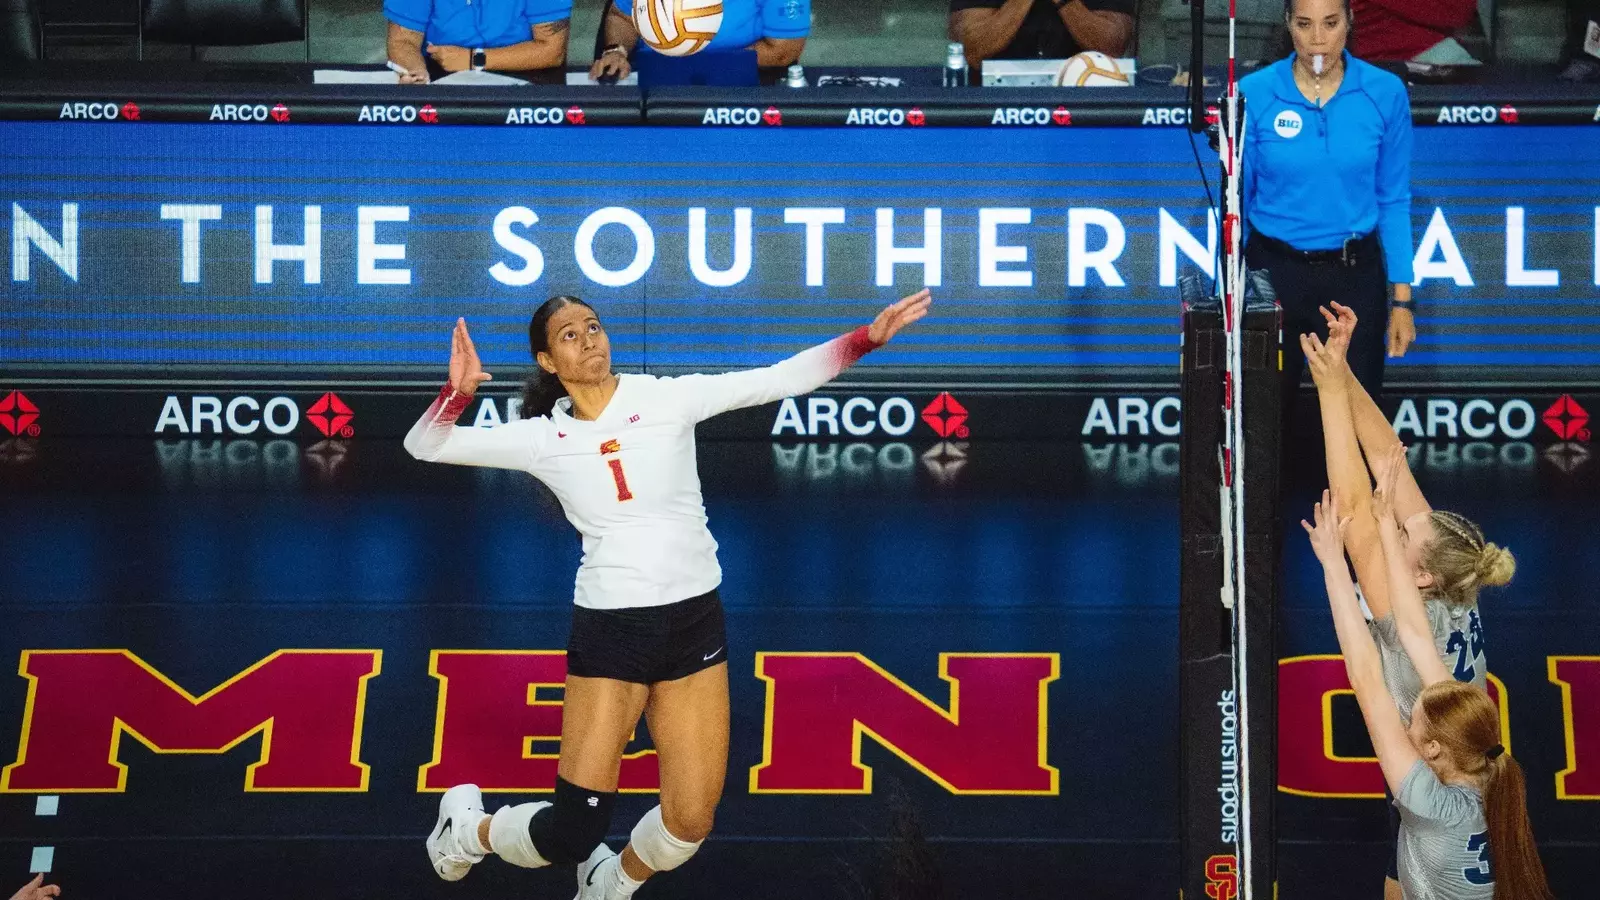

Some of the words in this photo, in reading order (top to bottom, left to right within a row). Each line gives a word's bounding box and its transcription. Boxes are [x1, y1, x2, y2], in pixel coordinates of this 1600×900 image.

[60, 103, 119, 120] ARCO
[209, 104, 268, 122] ARCO
[358, 106, 417, 123] ARCO
[505, 107, 564, 124] ARCO
[702, 108, 760, 125] ARCO
[846, 108, 905, 126] ARCO
[991, 108, 1050, 125] ARCO
[1142, 108, 1192, 124] ARC
[1437, 106, 1497, 123] ARCO
[160, 204, 412, 285] THE
[488, 206, 1219, 287] SOUTHERN
[1410, 206, 1600, 286] AL
[155, 396, 299, 434] ARCO
[771, 397, 915, 436] ARCO
[1082, 397, 1181, 436] ARC
[1392, 399, 1536, 439] ARCO
[607, 458, 633, 502] 1
[0, 648, 1061, 795] MEN
